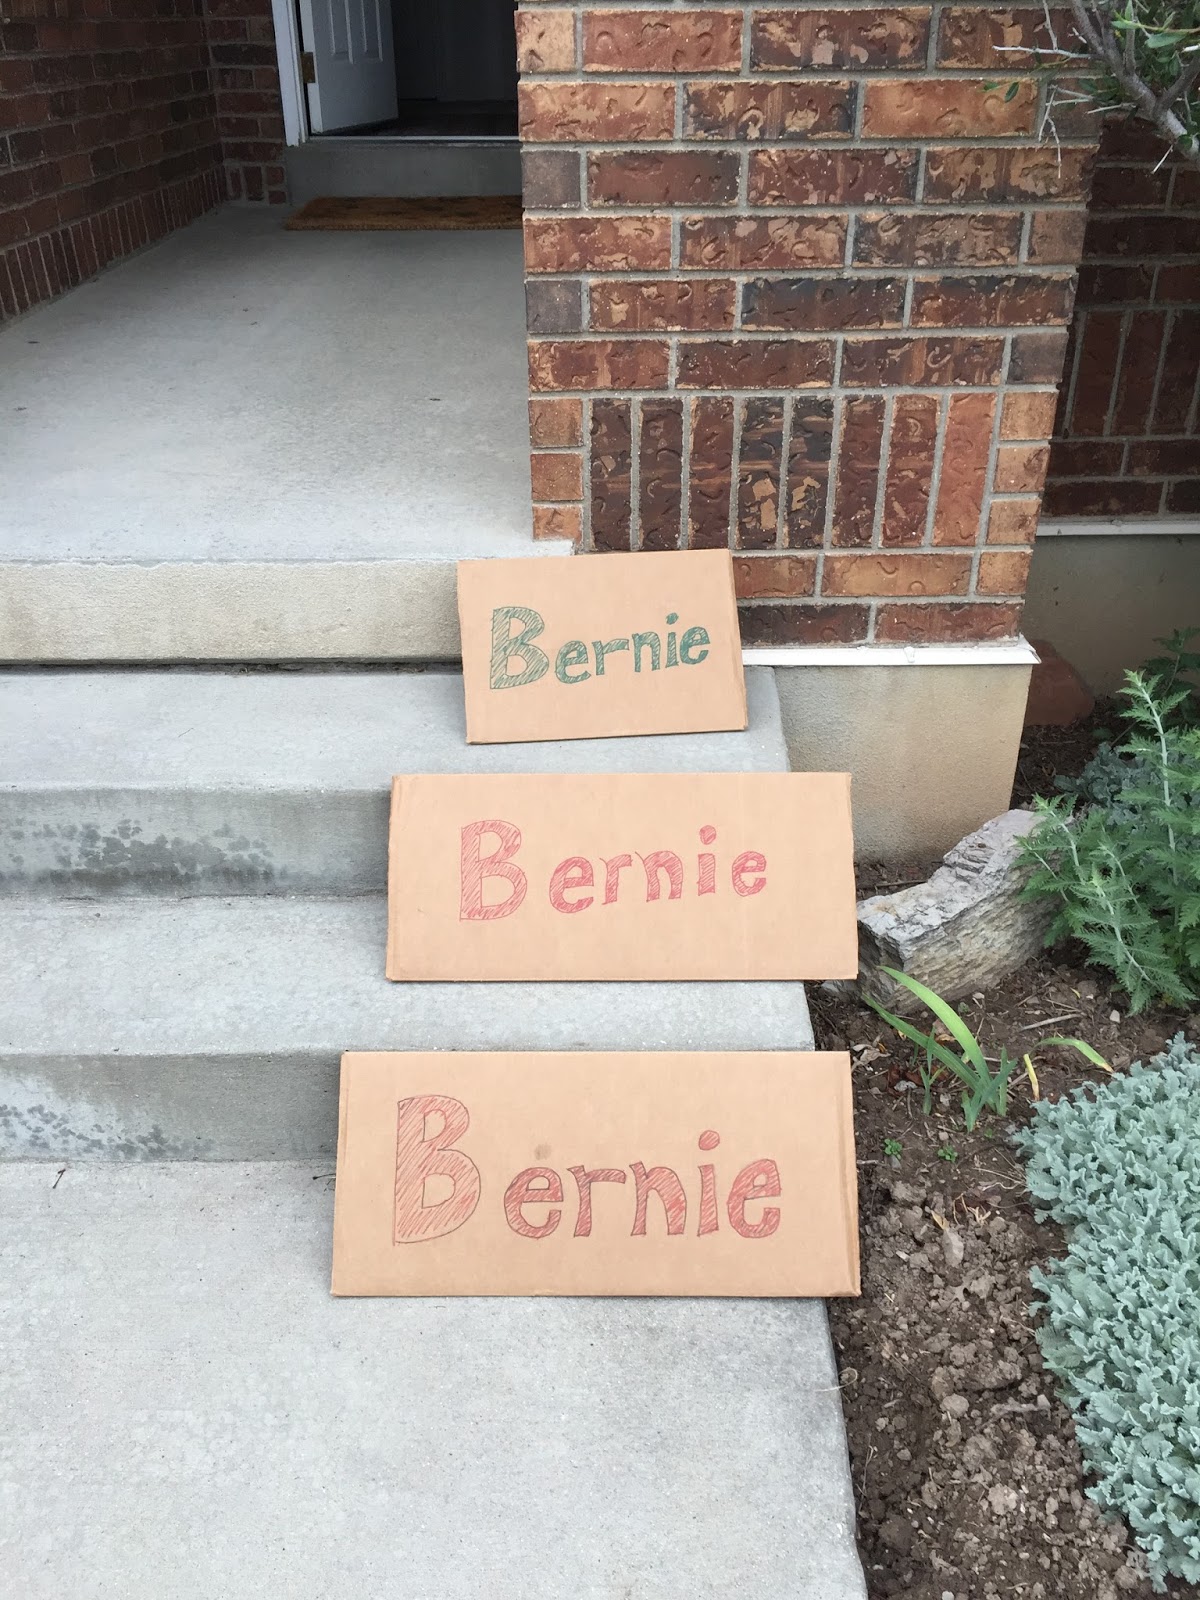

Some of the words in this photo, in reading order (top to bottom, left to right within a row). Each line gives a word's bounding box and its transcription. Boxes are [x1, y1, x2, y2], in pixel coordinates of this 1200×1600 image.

[490, 606, 711, 689] Bernie
[459, 819, 767, 921] Bernie
[393, 1094, 782, 1245] Bernie
